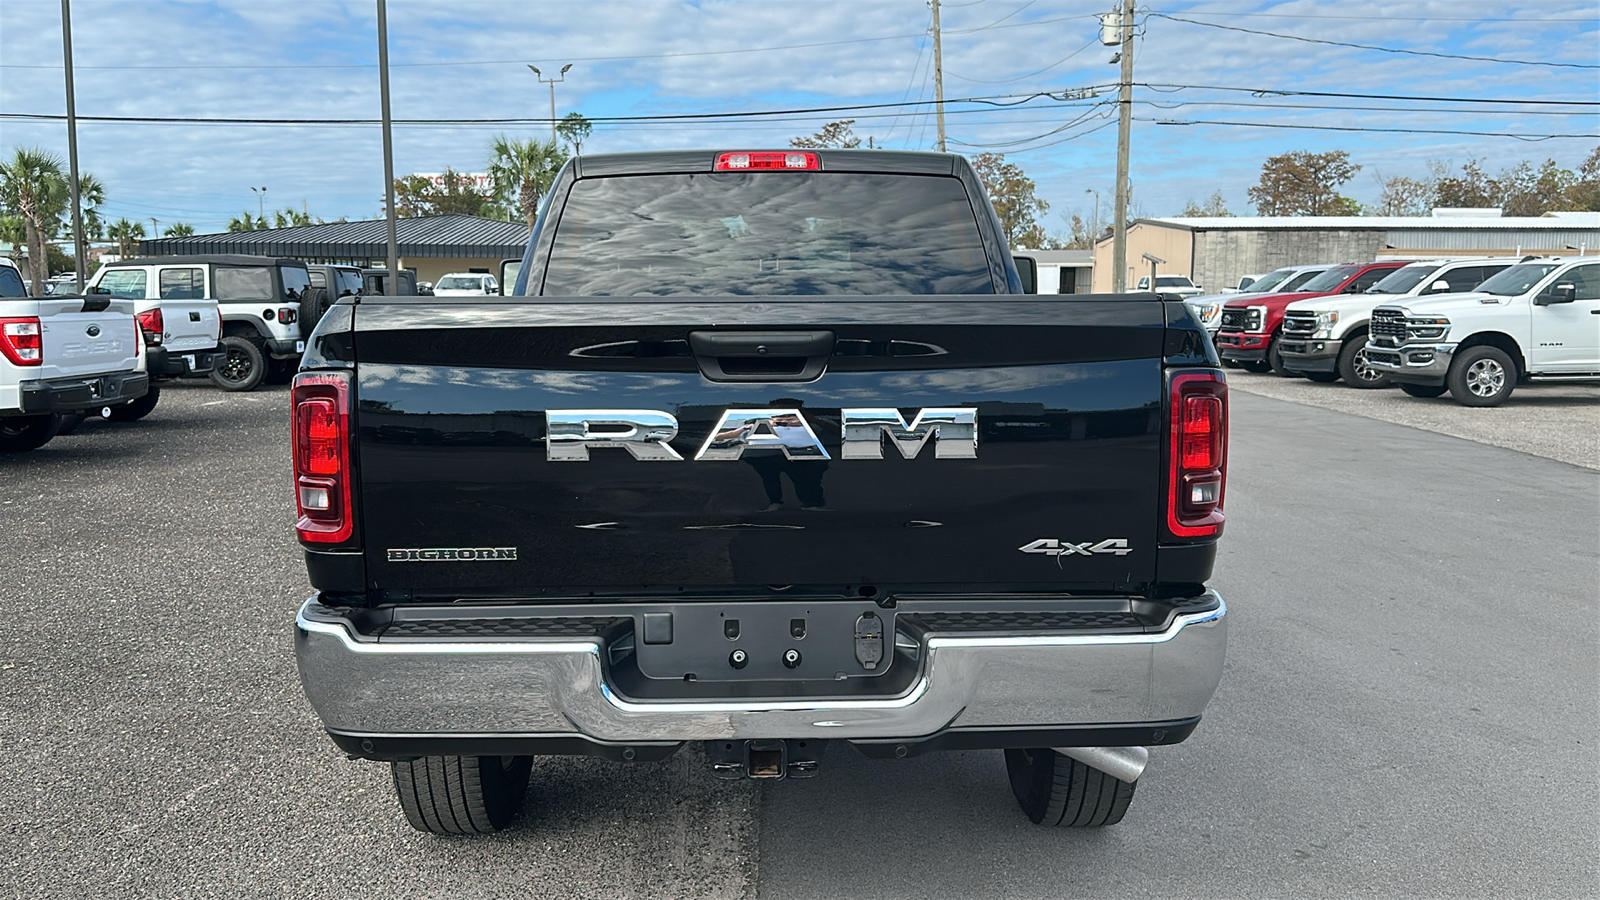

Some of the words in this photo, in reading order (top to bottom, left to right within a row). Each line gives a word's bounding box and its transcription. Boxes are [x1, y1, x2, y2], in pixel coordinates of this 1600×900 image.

[545, 407, 979, 462] RAM
[387, 547, 517, 561] BIGHORN
[1018, 538, 1133, 556] 4x4
